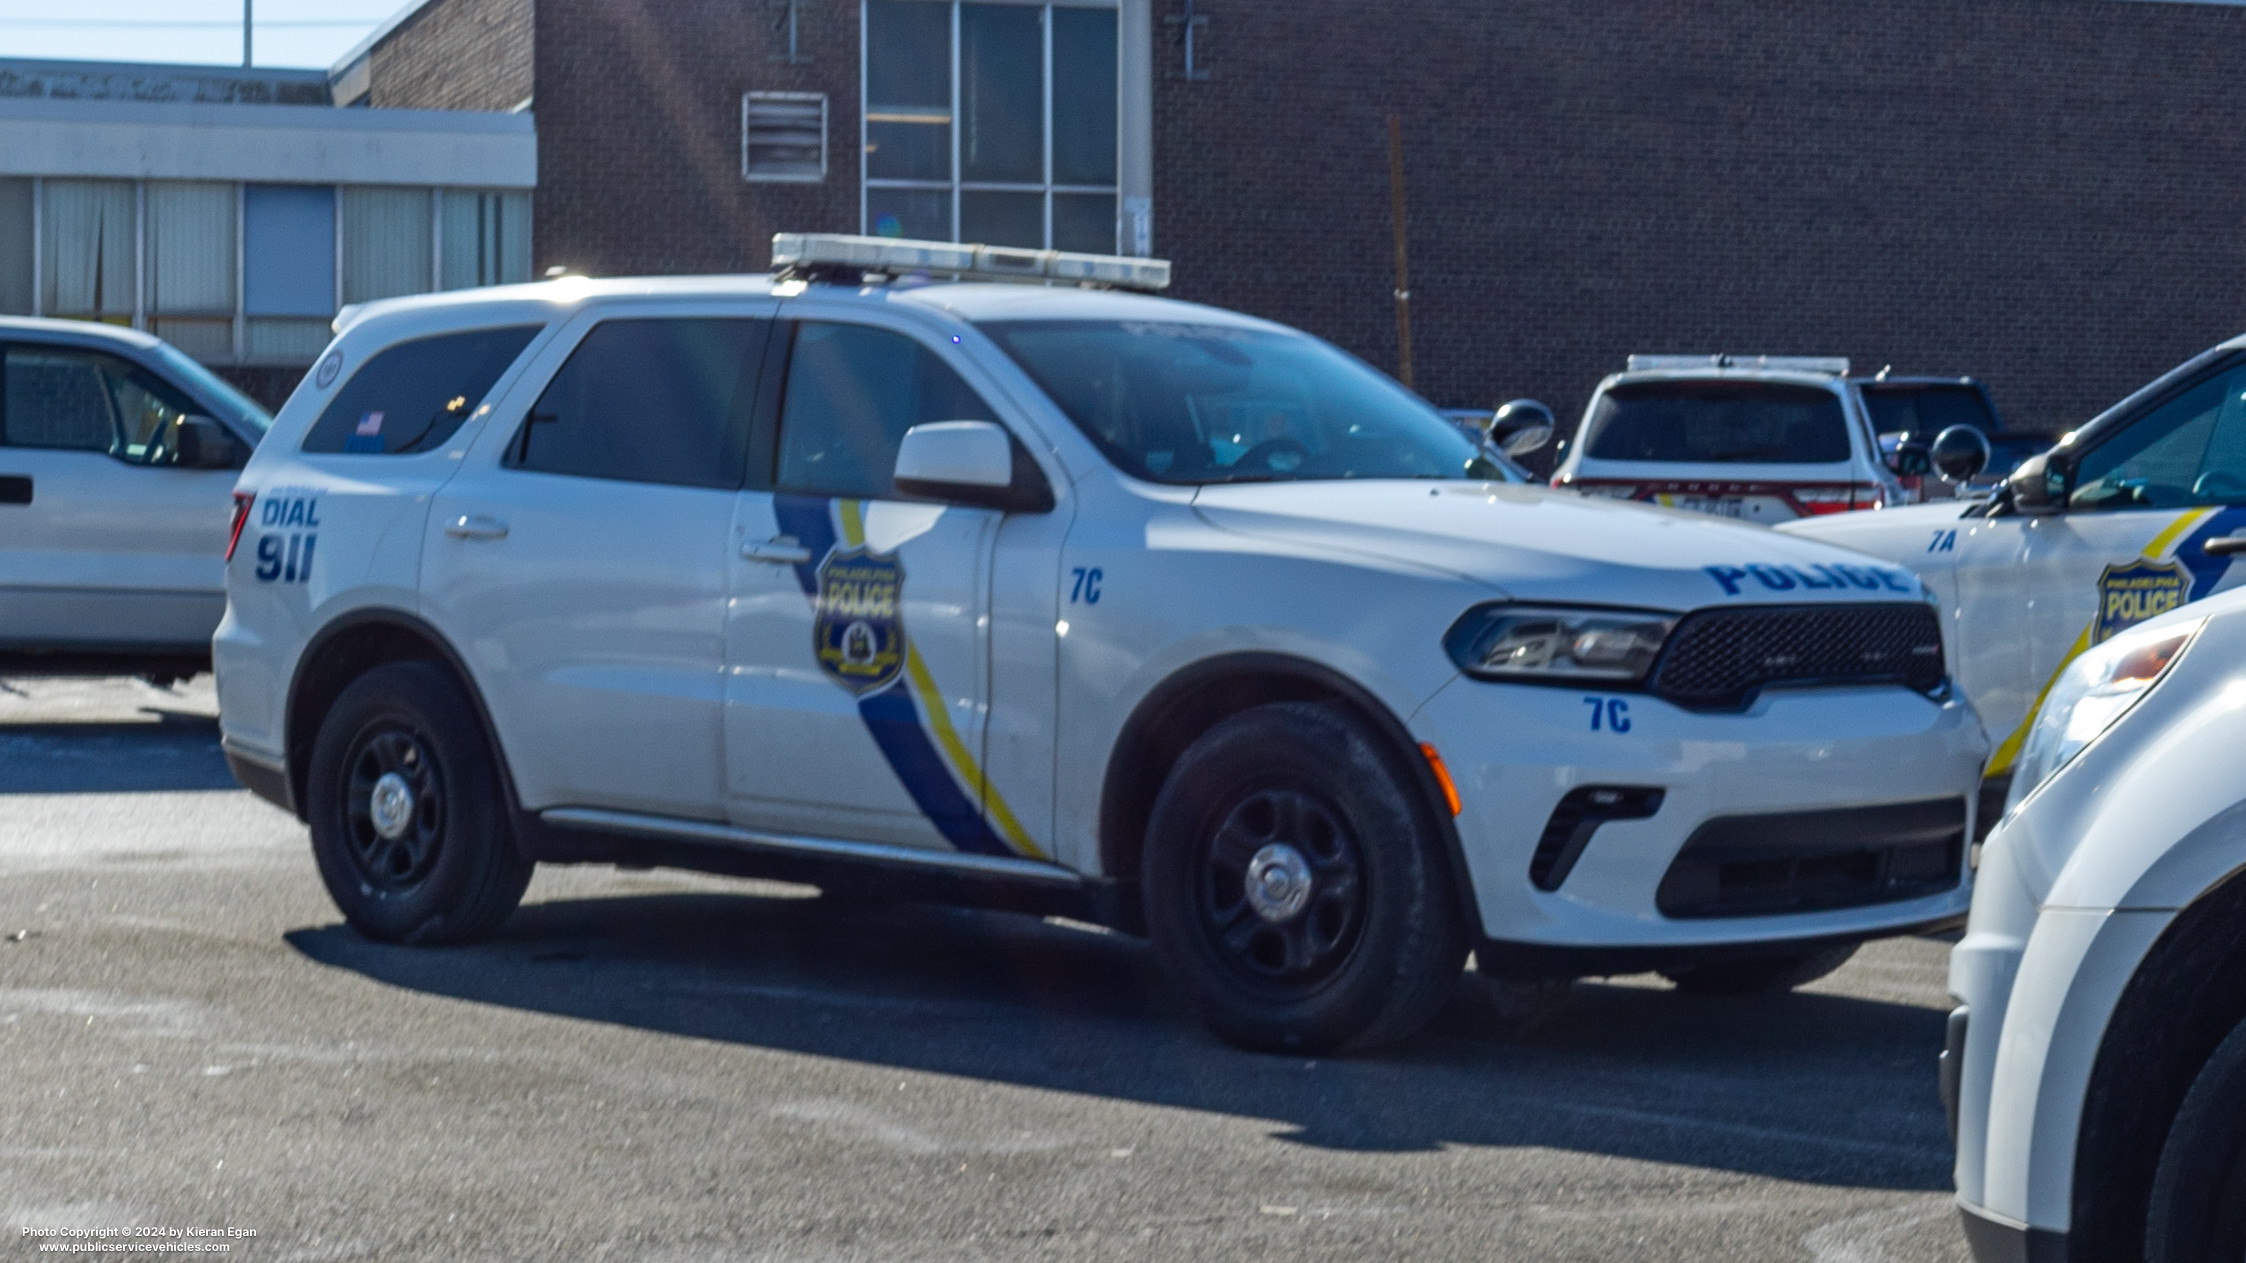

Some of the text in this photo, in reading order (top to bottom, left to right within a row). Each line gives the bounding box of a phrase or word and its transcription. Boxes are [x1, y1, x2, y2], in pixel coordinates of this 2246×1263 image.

[261, 498, 321, 527] DIAL
[1927, 529, 1958, 552] 7A
[255, 533, 318, 584] 911
[1070, 567, 1103, 605] 7C
[1703, 563, 1912, 595] POLICE
[828, 582, 895, 617] POLICE
[2107, 590, 2178, 619] POLICE
[1583, 697, 1631, 733] 7C
